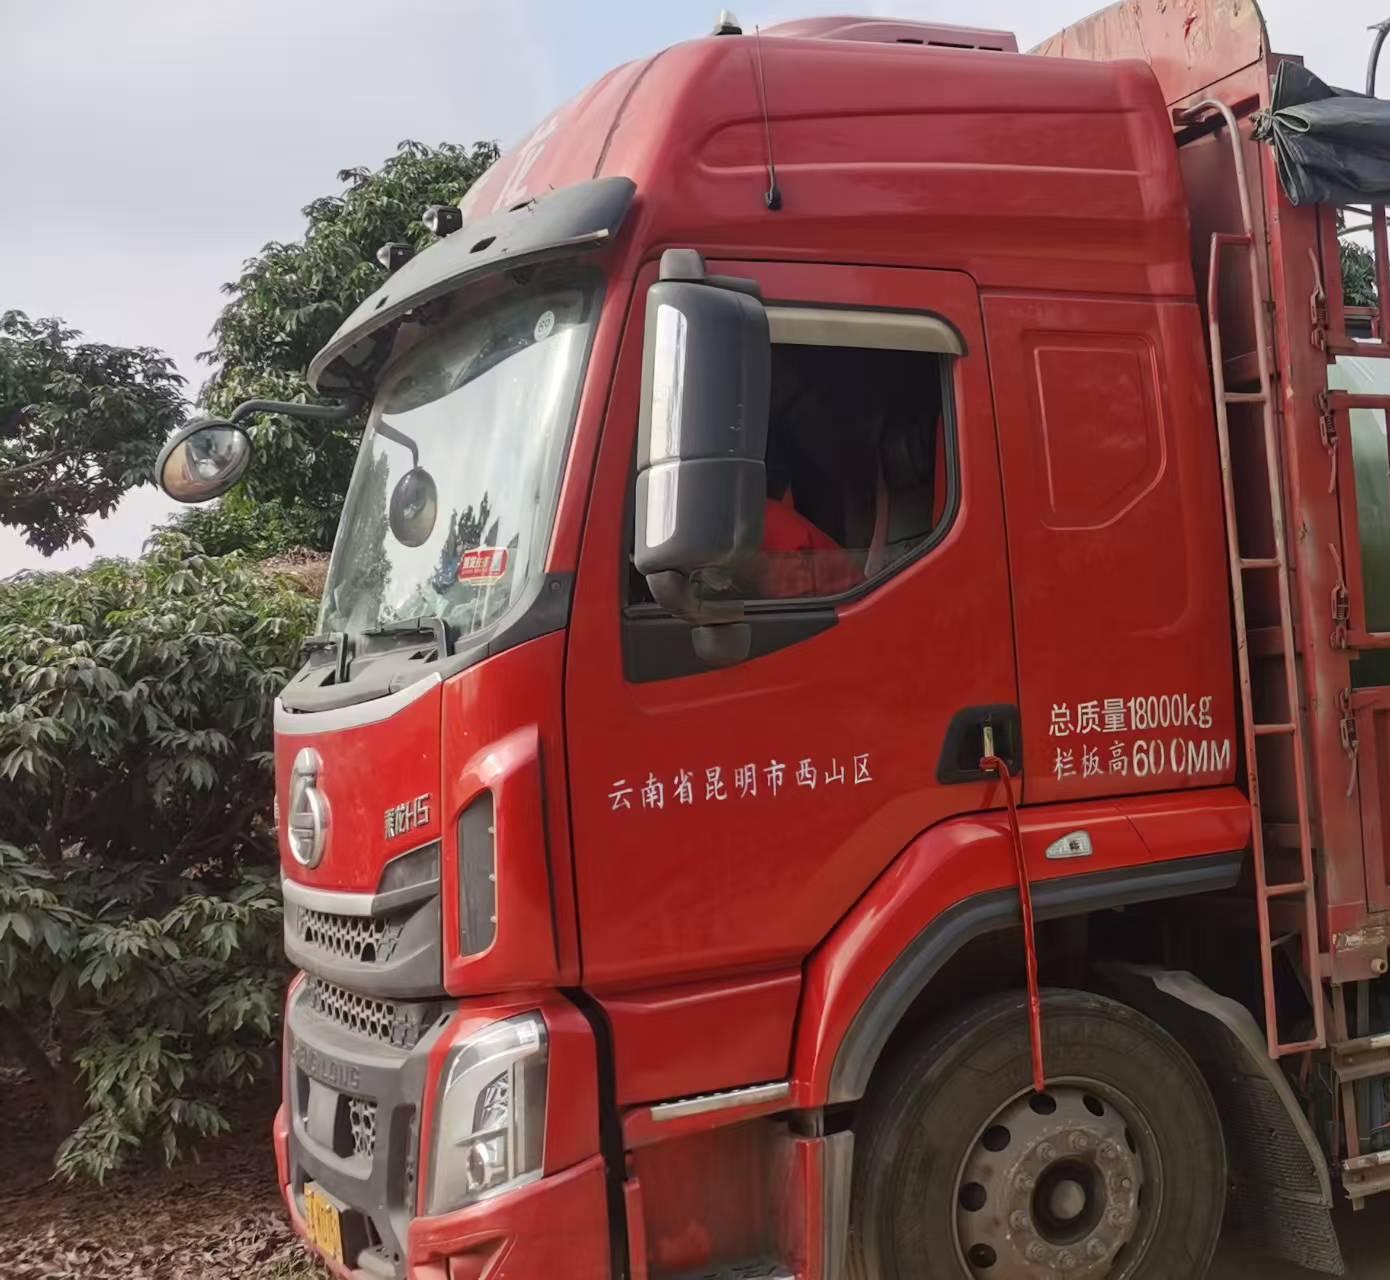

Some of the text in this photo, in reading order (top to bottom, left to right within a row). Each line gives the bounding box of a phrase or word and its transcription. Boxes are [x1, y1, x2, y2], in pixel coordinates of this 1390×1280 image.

[1048, 692, 1213, 737] 总质量18000kg
[607, 752, 874, 811] 云南省昆明市西山区
[1053, 737, 1231, 781] 栏板高600MM
